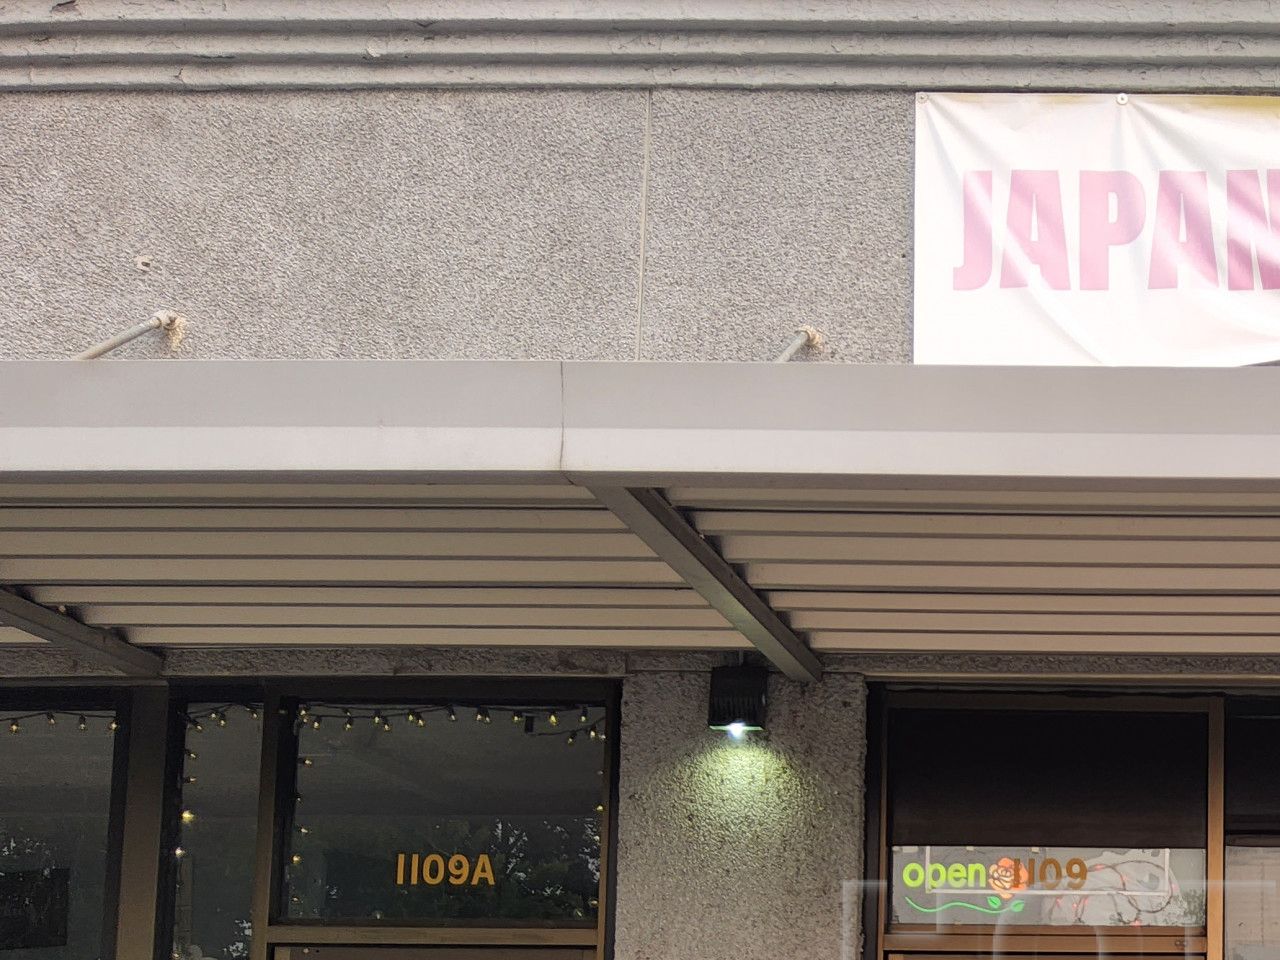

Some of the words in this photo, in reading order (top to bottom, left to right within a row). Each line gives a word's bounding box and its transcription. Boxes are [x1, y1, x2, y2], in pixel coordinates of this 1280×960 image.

[395, 852, 496, 887] 1109A
[902, 862, 987, 893] open
[1013, 857, 1089, 891] 1109
